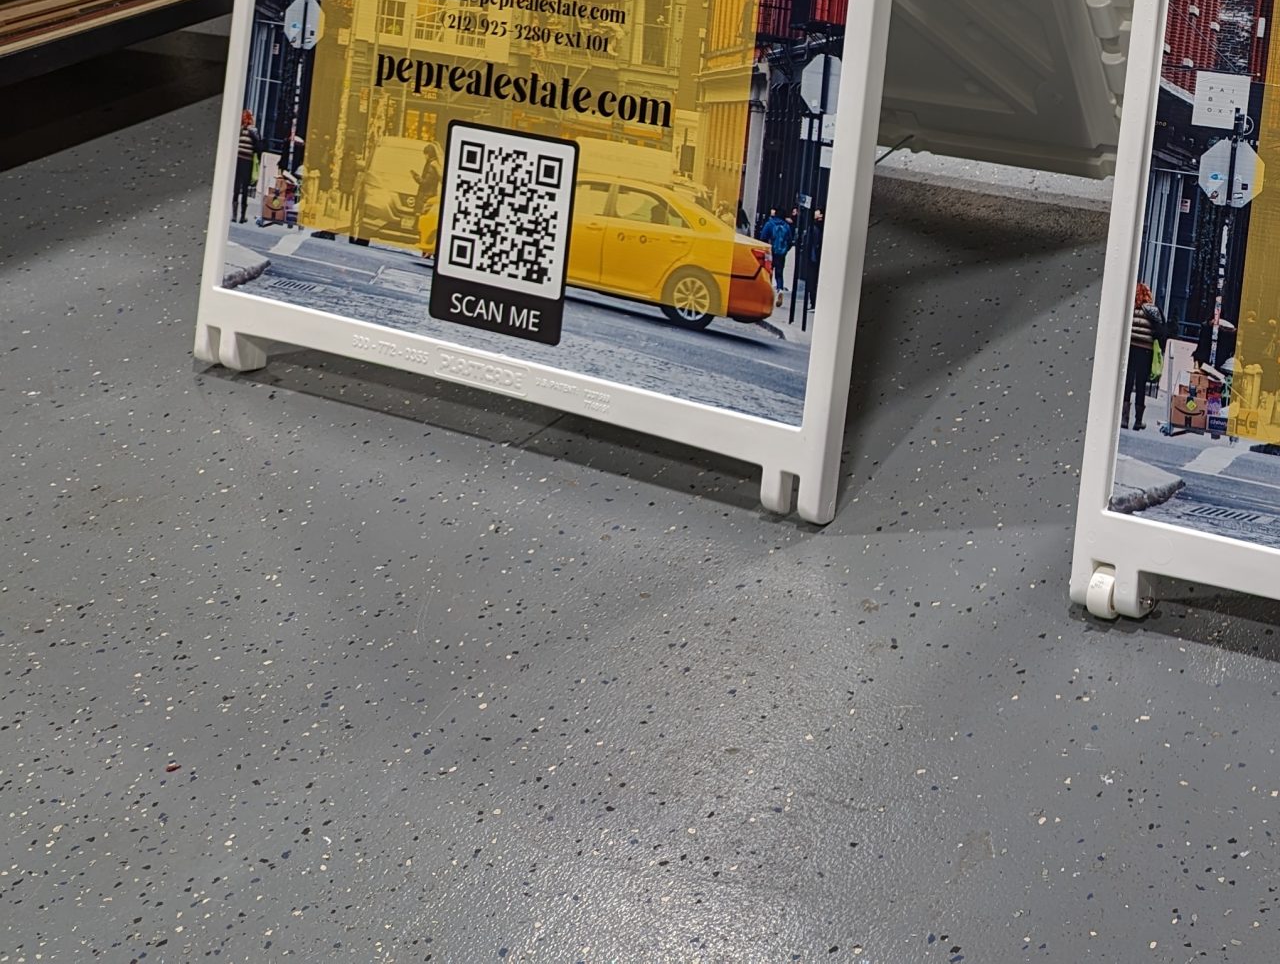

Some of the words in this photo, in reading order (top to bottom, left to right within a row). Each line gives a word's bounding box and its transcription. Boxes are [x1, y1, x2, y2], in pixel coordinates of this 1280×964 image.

[481, 18, 551, 44] 925-3280
[554, 31, 581, 48] ext
[586, 35, 609, 53] 101
[374, 53, 672, 128] peprealestate.com
[450, 293, 503, 323] SCAN
[509, 306, 541, 332] ME
